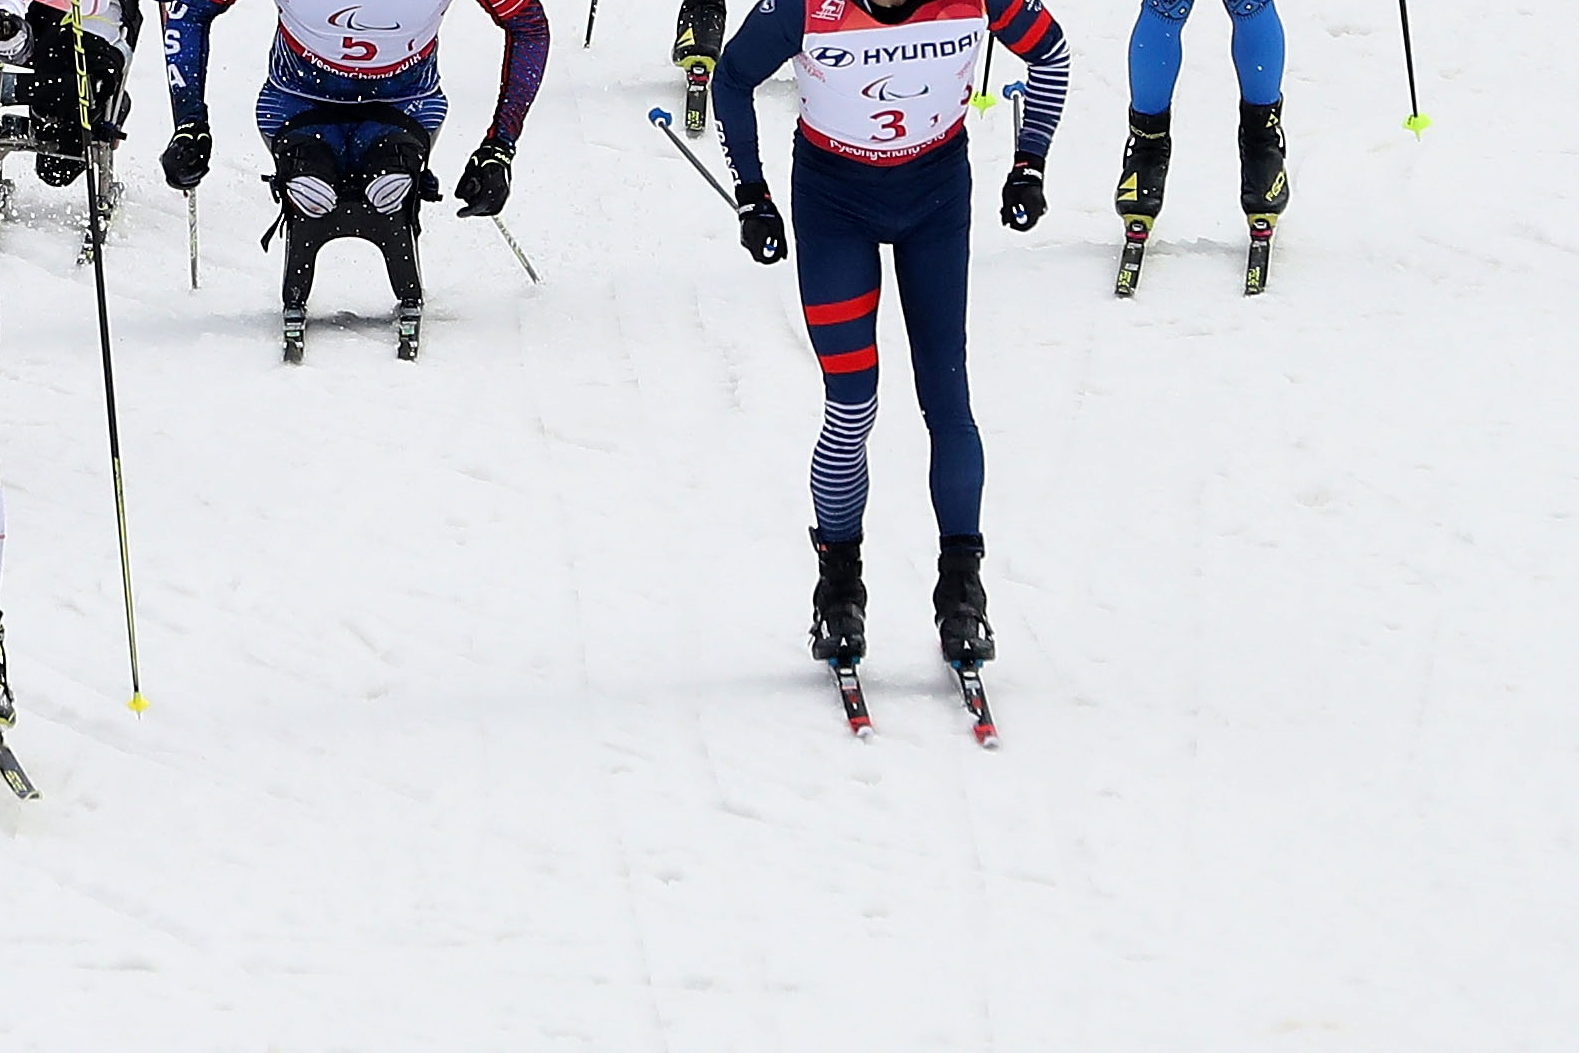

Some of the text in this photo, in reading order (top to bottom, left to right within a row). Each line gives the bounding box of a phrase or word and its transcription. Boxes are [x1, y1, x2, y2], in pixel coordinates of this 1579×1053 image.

[165, 0, 188, 88] USA
[341, 36, 379, 61] 5
[863, 31, 980, 66] HYUNDAI
[870, 110, 908, 142] 3
